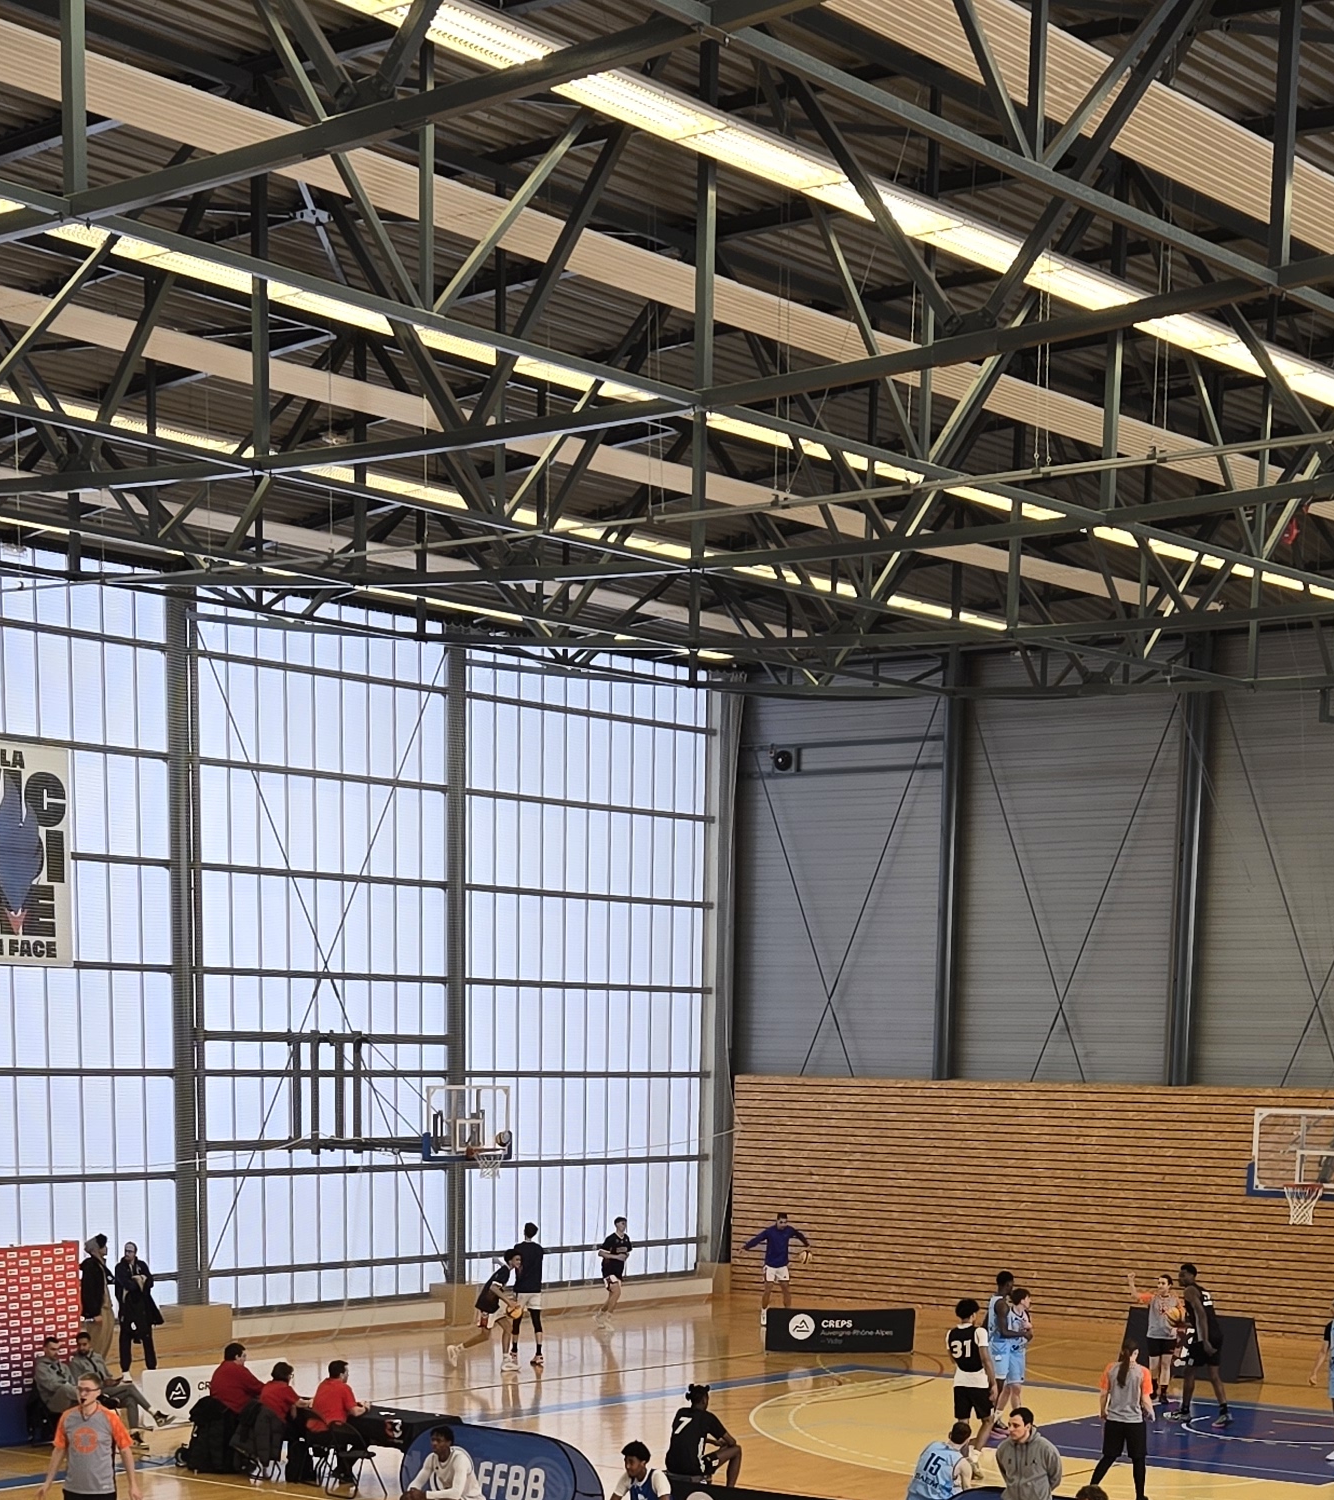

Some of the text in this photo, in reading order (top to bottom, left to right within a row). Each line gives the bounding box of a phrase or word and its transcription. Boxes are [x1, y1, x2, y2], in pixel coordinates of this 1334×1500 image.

[0, 749, 25, 769] LA
[9, 938, 57, 958] FACE
[821, 1319, 852, 1328] CREPS
[950, 1340, 972, 1359] 31
[674, 1417, 692, 1434] 7
[923, 1452, 946, 1476] 15
